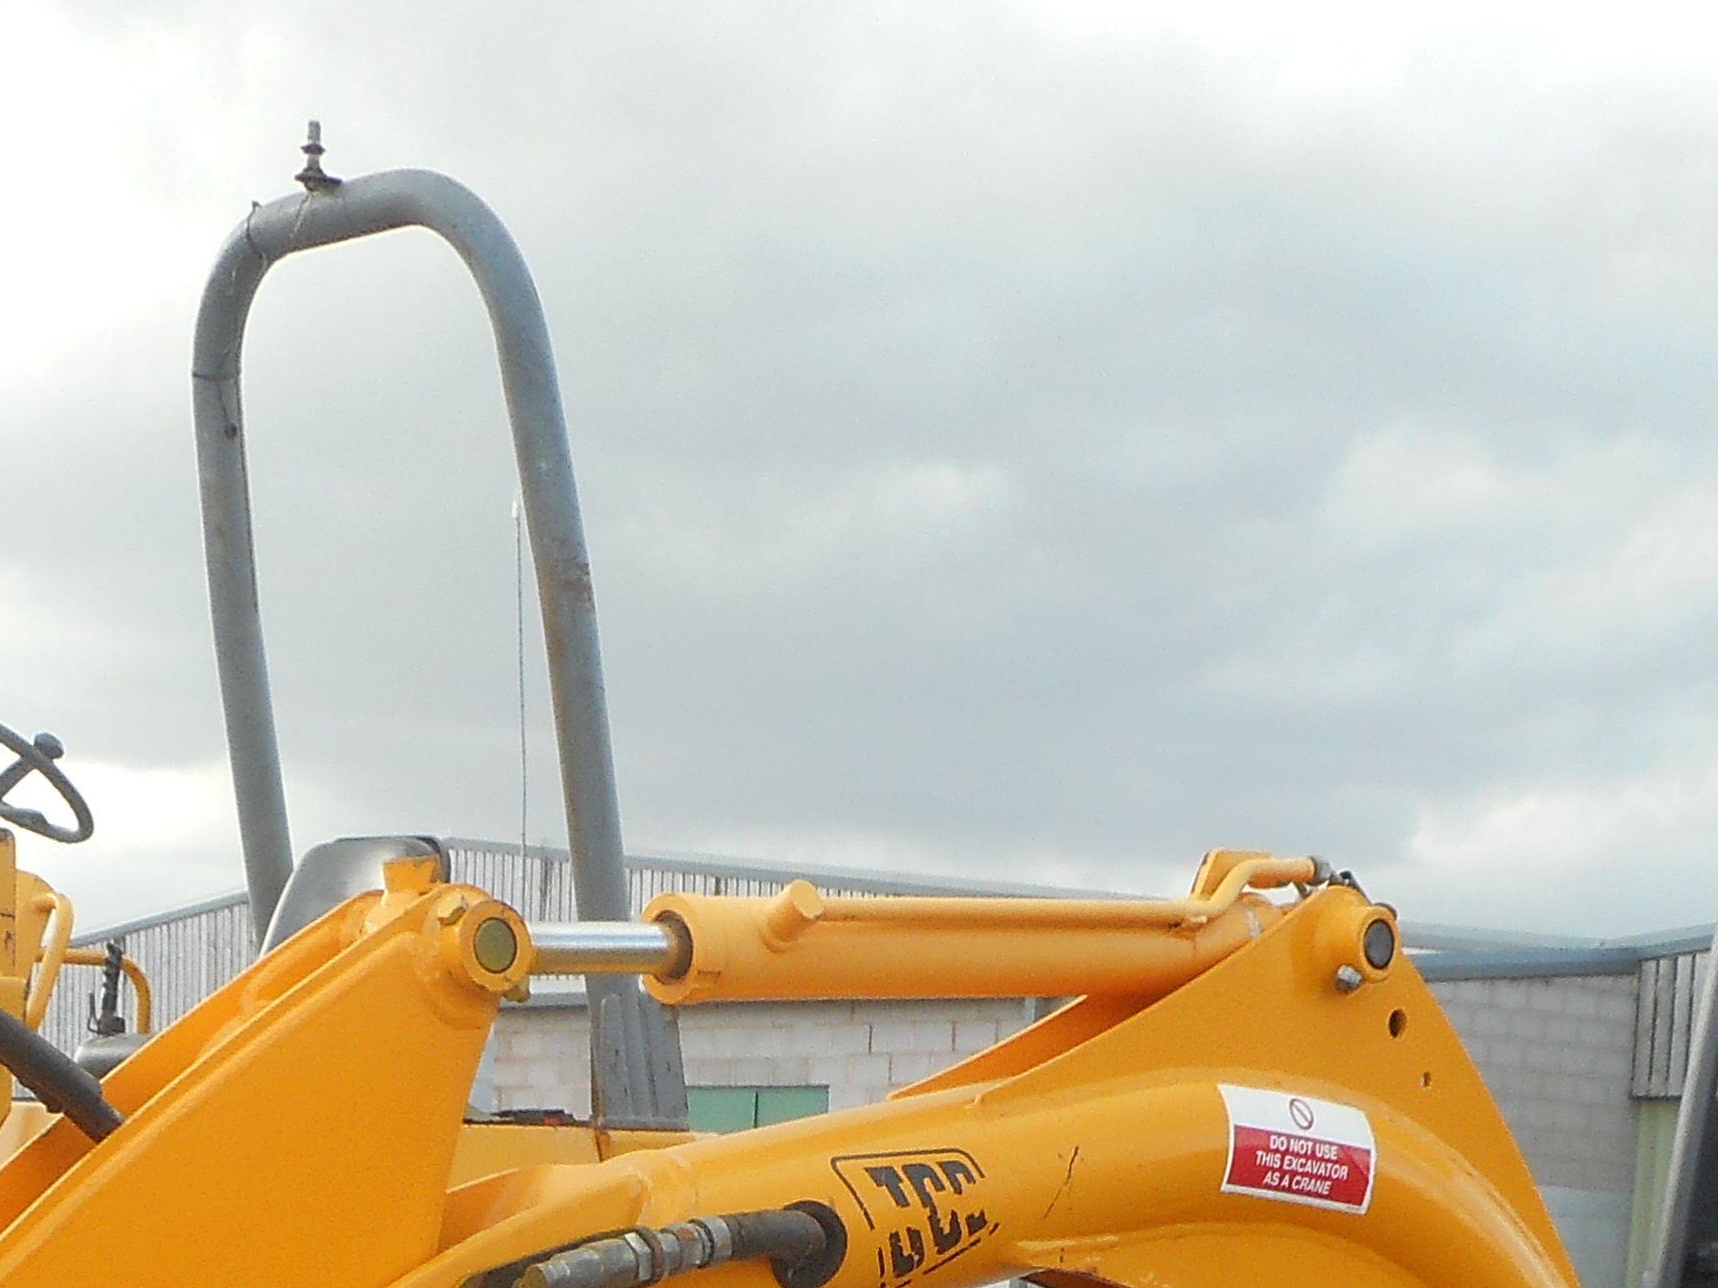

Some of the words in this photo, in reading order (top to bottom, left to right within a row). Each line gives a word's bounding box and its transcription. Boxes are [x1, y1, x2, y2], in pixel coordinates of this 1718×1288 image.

[1269, 1135, 1287, 1150] DO
[1289, 1138, 1313, 1154] NOT
[1315, 1143, 1338, 1160] USE
[1256, 1150, 1281, 1168] THIS
[1283, 1156, 1349, 1180] EXCAVATOR
[1263, 1171, 1280, 1186] AS
[1281, 1174, 1290, 1188] A
[1291, 1176, 1333, 1195] CRANE
